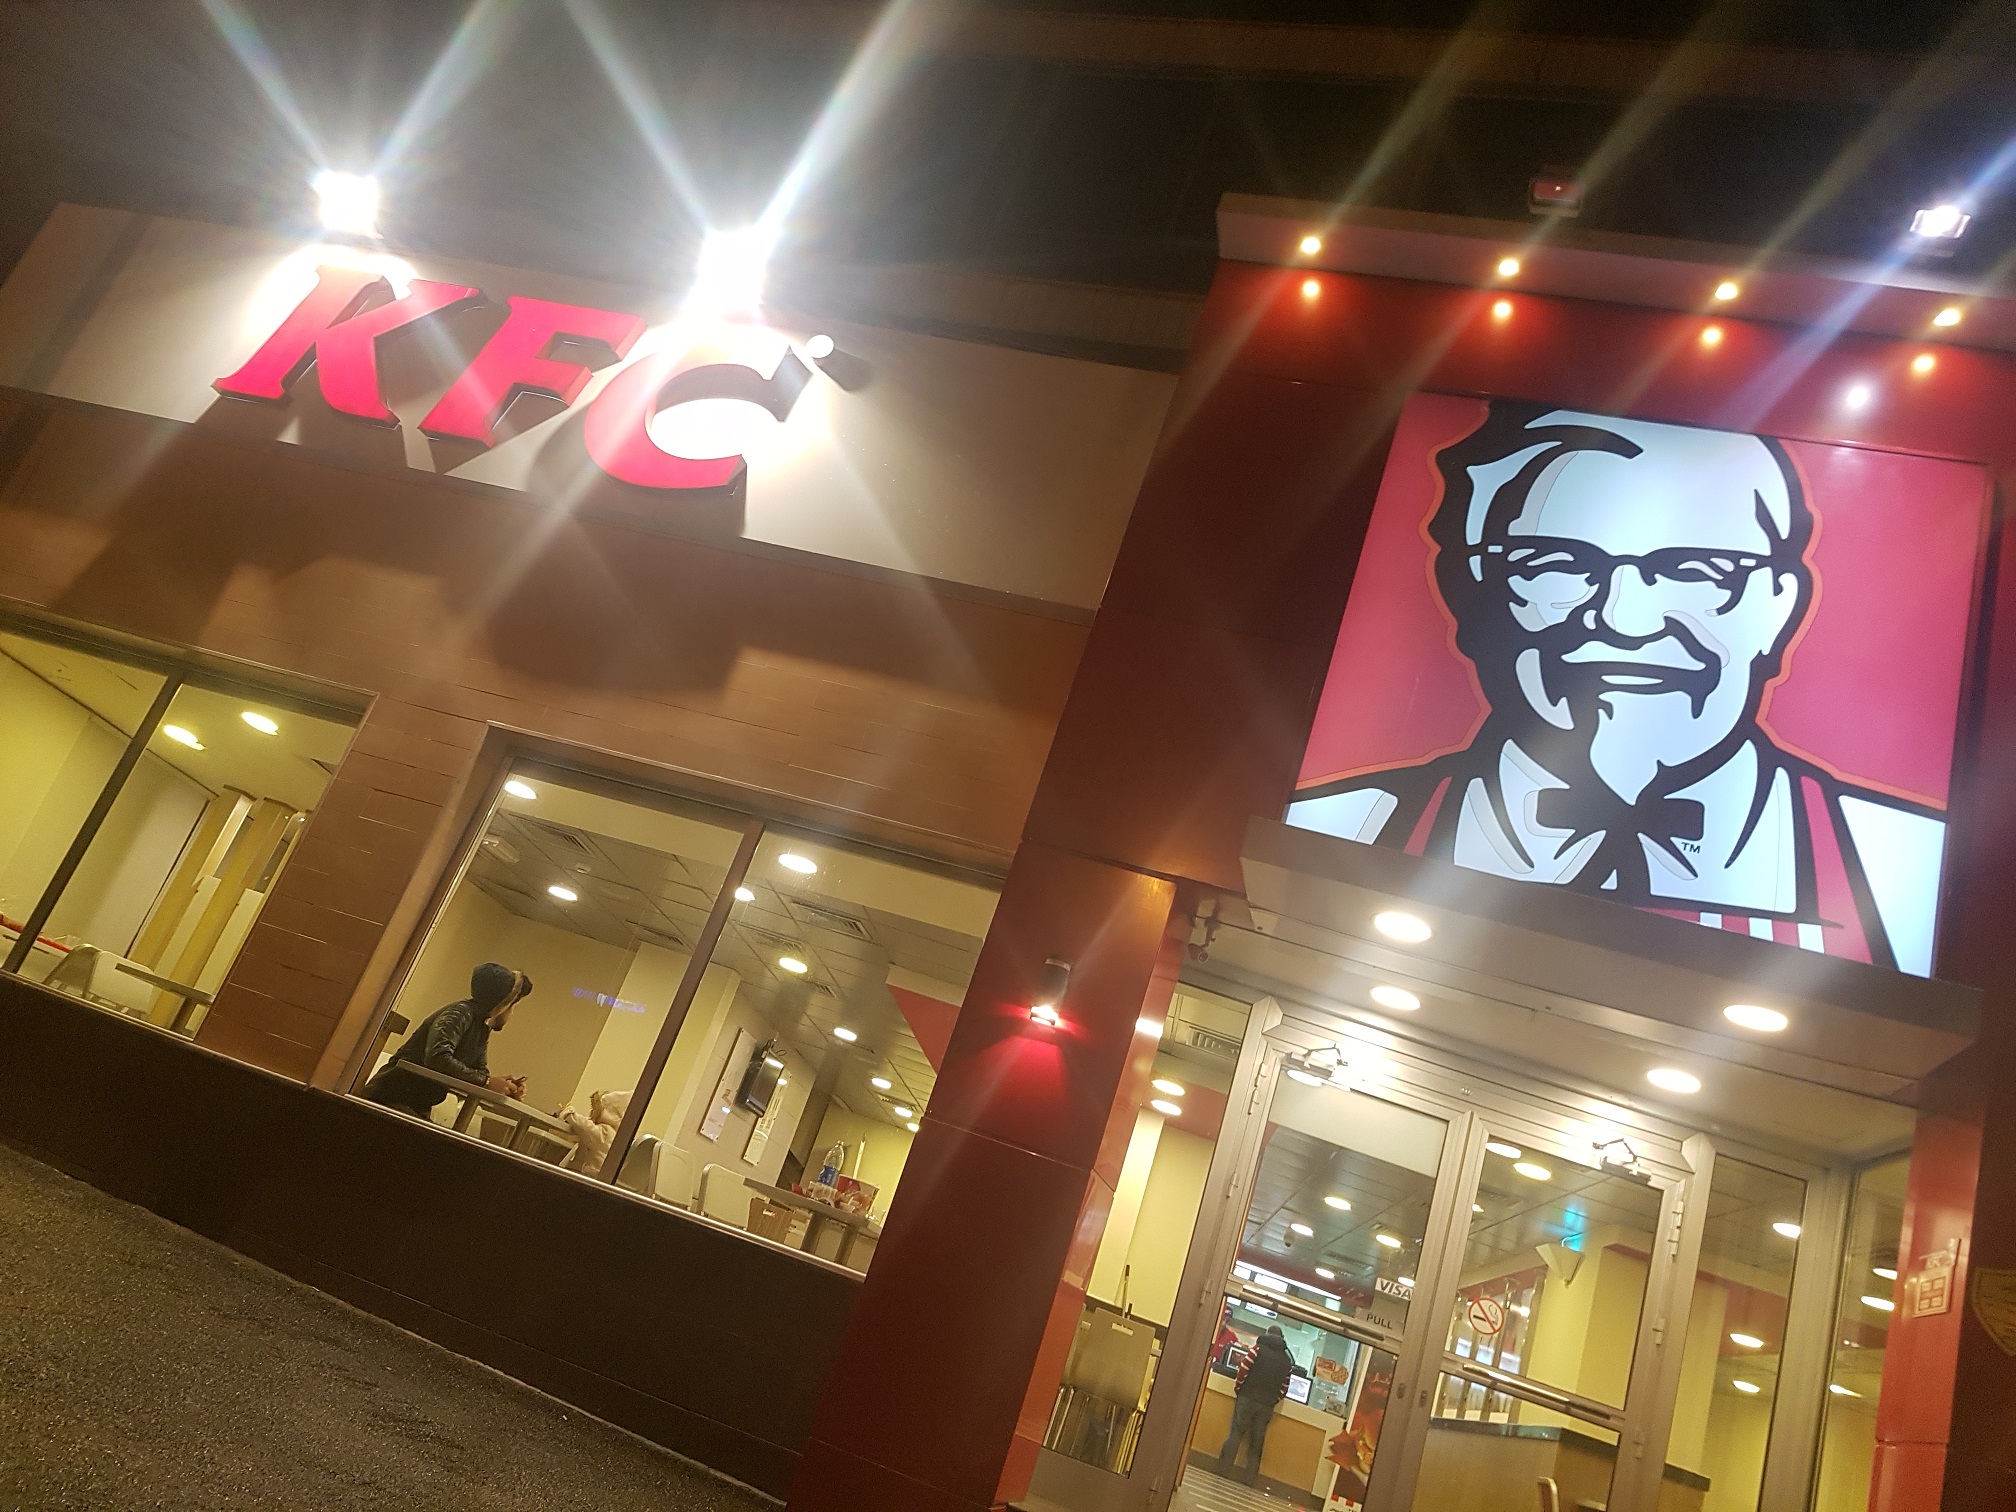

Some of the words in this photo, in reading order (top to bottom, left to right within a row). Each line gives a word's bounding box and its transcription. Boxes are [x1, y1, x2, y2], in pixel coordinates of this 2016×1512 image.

[211, 264, 813, 494] KFC
[1682, 842, 1701, 854] TM
[1380, 1279, 1411, 1300] VISA
[1366, 1313, 1392, 1329] PULL
